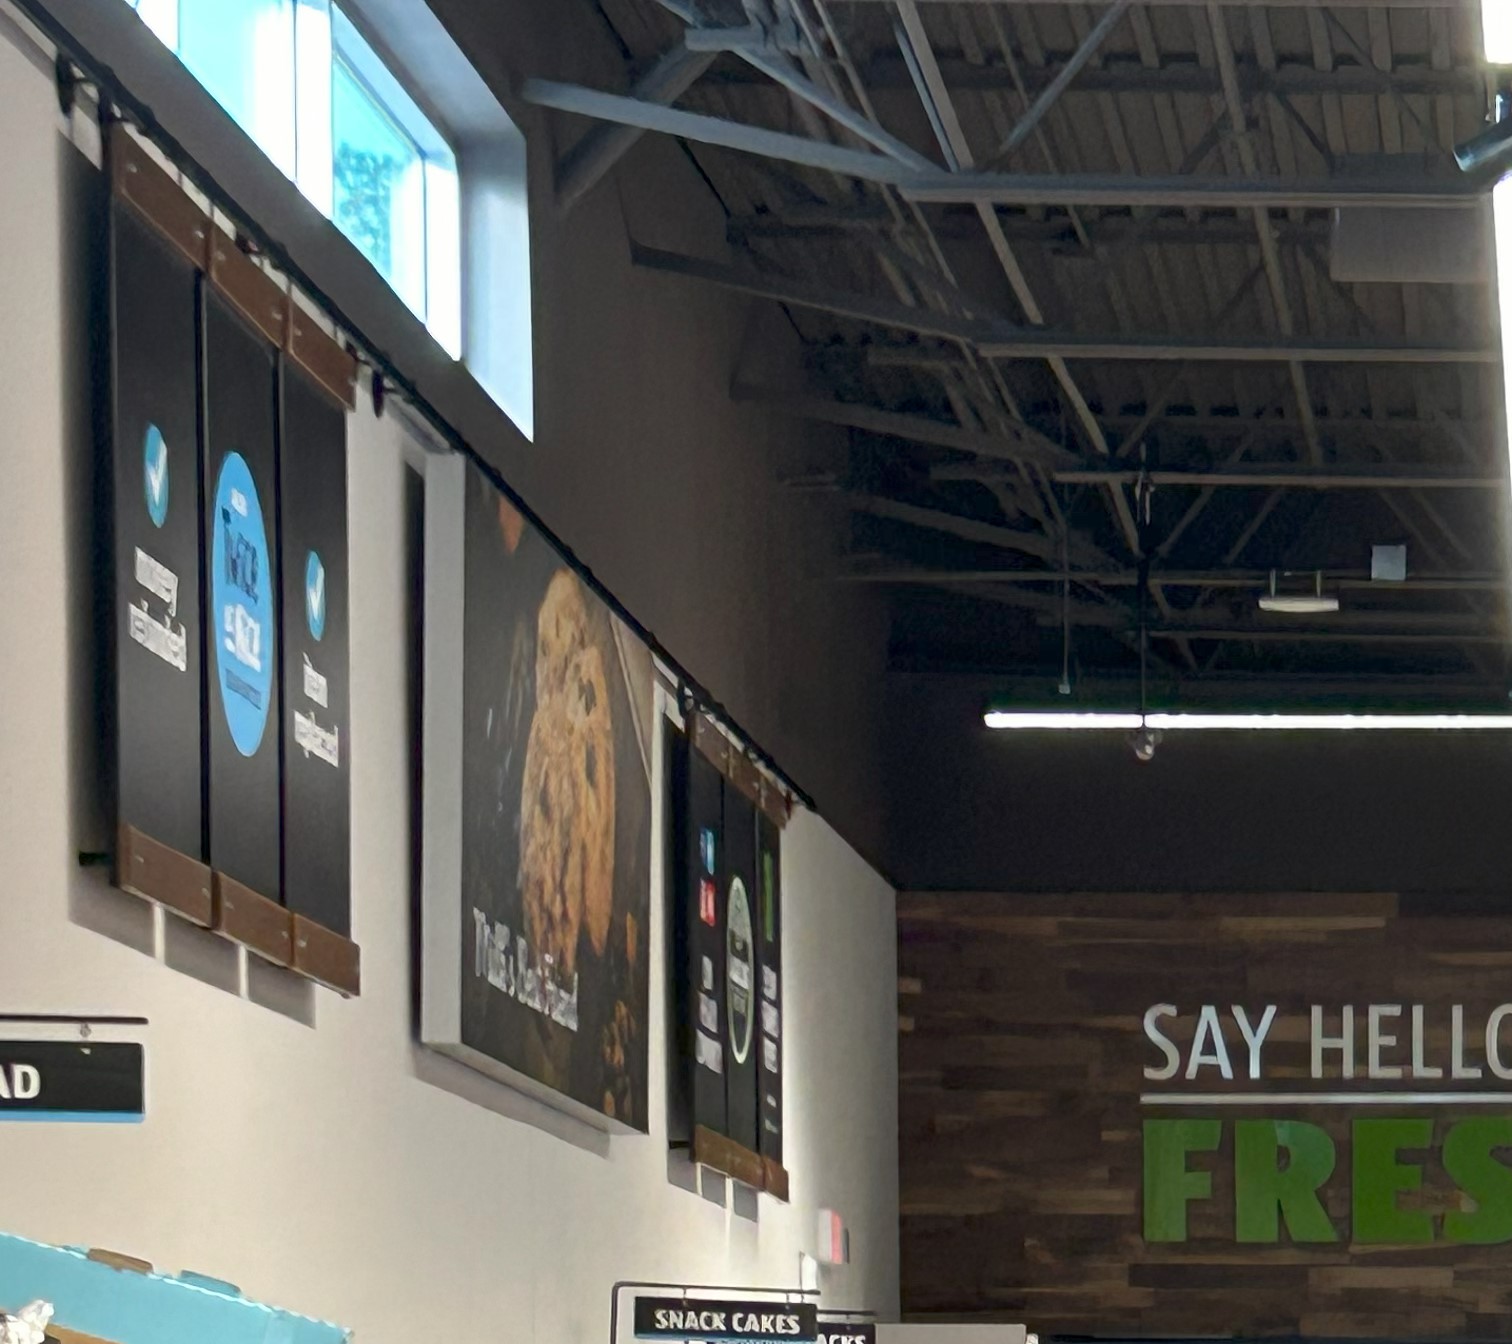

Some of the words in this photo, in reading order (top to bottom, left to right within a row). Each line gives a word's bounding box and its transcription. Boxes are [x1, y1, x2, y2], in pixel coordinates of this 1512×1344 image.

[1143, 1002, 1277, 1080] SAY
[654, 1309, 727, 1331] SNACK
[731, 1312, 801, 1335] CAKES
